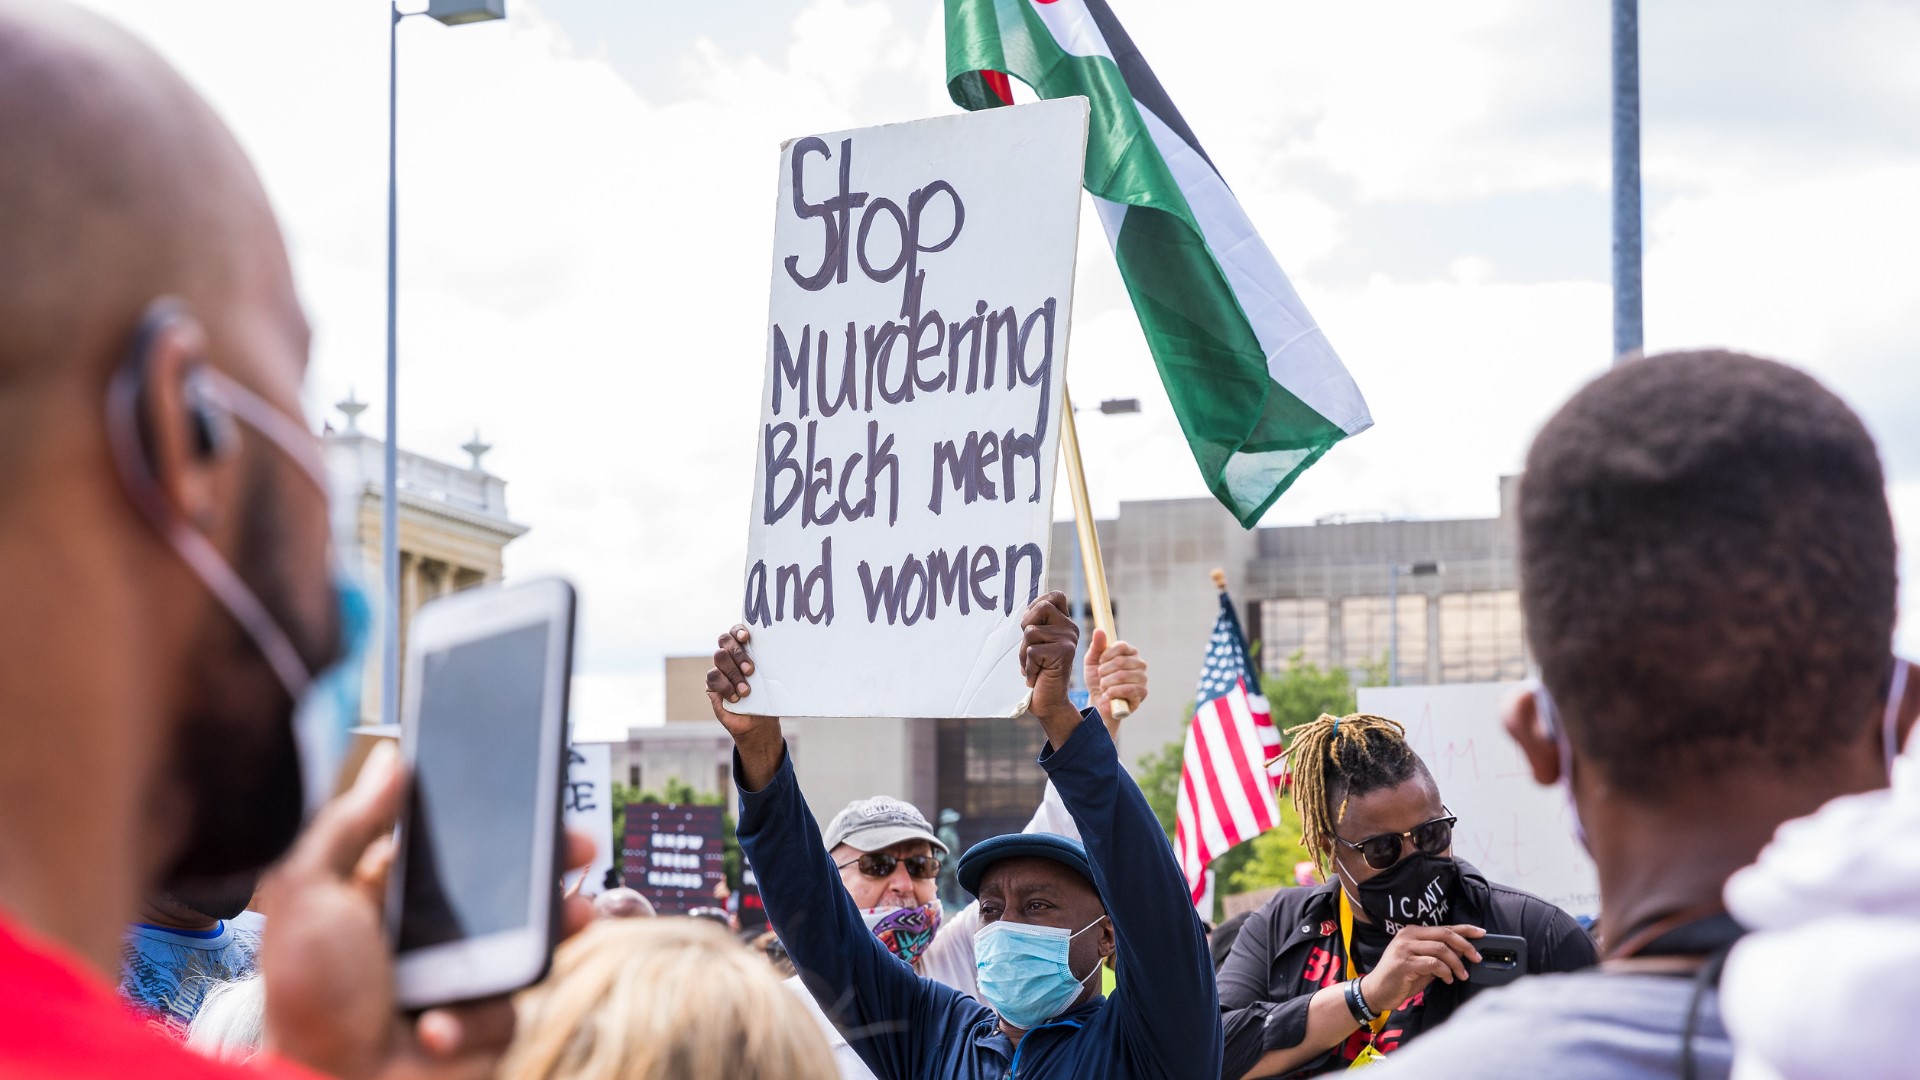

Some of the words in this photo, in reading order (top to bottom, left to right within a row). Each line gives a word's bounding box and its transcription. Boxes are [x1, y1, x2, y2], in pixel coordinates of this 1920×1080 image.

[785, 136, 965, 318] Stop
[771, 269, 1056, 447] Murdering
[764, 420, 898, 529] Black
[928, 430, 1042, 516] men
[744, 536, 835, 628] and
[857, 542, 1043, 627] women
[1388, 894, 1395, 918] I
[1400, 875, 1444, 918] CAN'T
